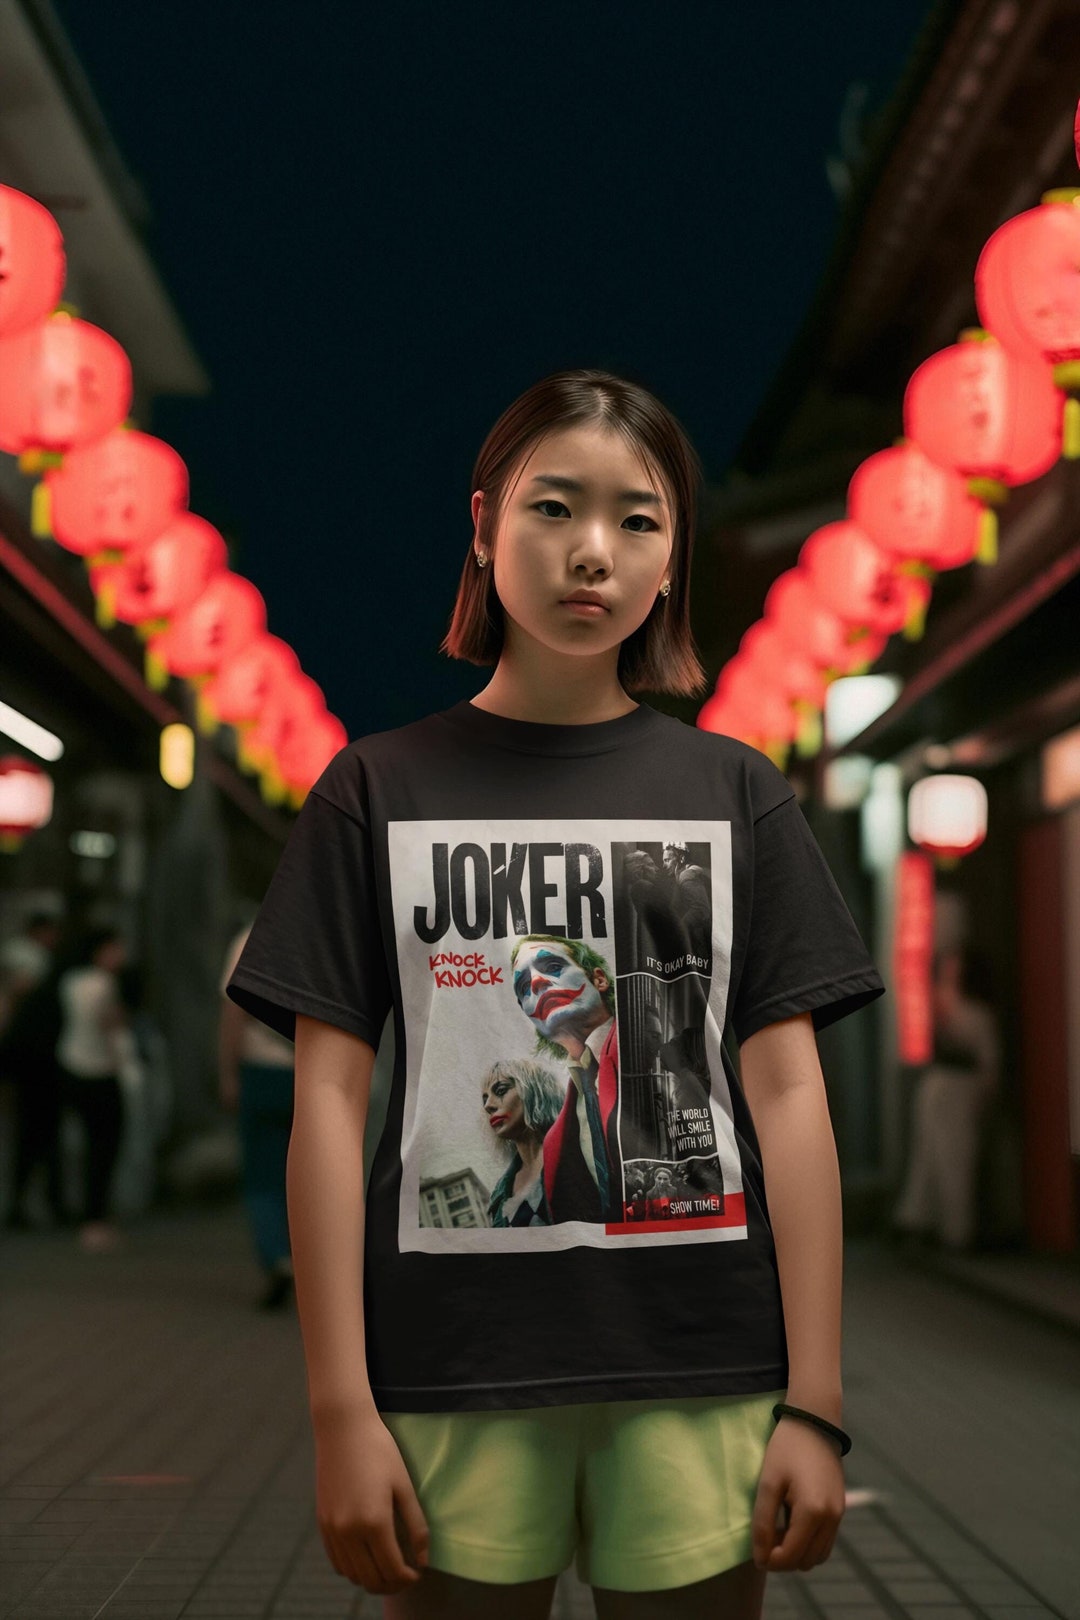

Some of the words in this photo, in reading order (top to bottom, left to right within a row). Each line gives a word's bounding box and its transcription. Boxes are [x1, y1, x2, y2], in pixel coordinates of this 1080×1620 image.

[413, 842, 608, 944] JOKER
[646, 956, 663, 972] IT'S
[664, 955, 685, 973] OKAY
[686, 954, 709, 969] BABY
[434, 966, 504, 988] KNOCK
[667, 1110, 680, 1122] THE
[681, 1108, 709, 1120] WORLD
[668, 1124, 687, 1139] WILL
[687, 1121, 711, 1134] SMILE
[676, 1137, 697, 1152] WITH
[698, 1134, 713, 1148] YOU
[669, 1200, 692, 1214] SHOW
[694, 1199, 720, 1212] TIME!
